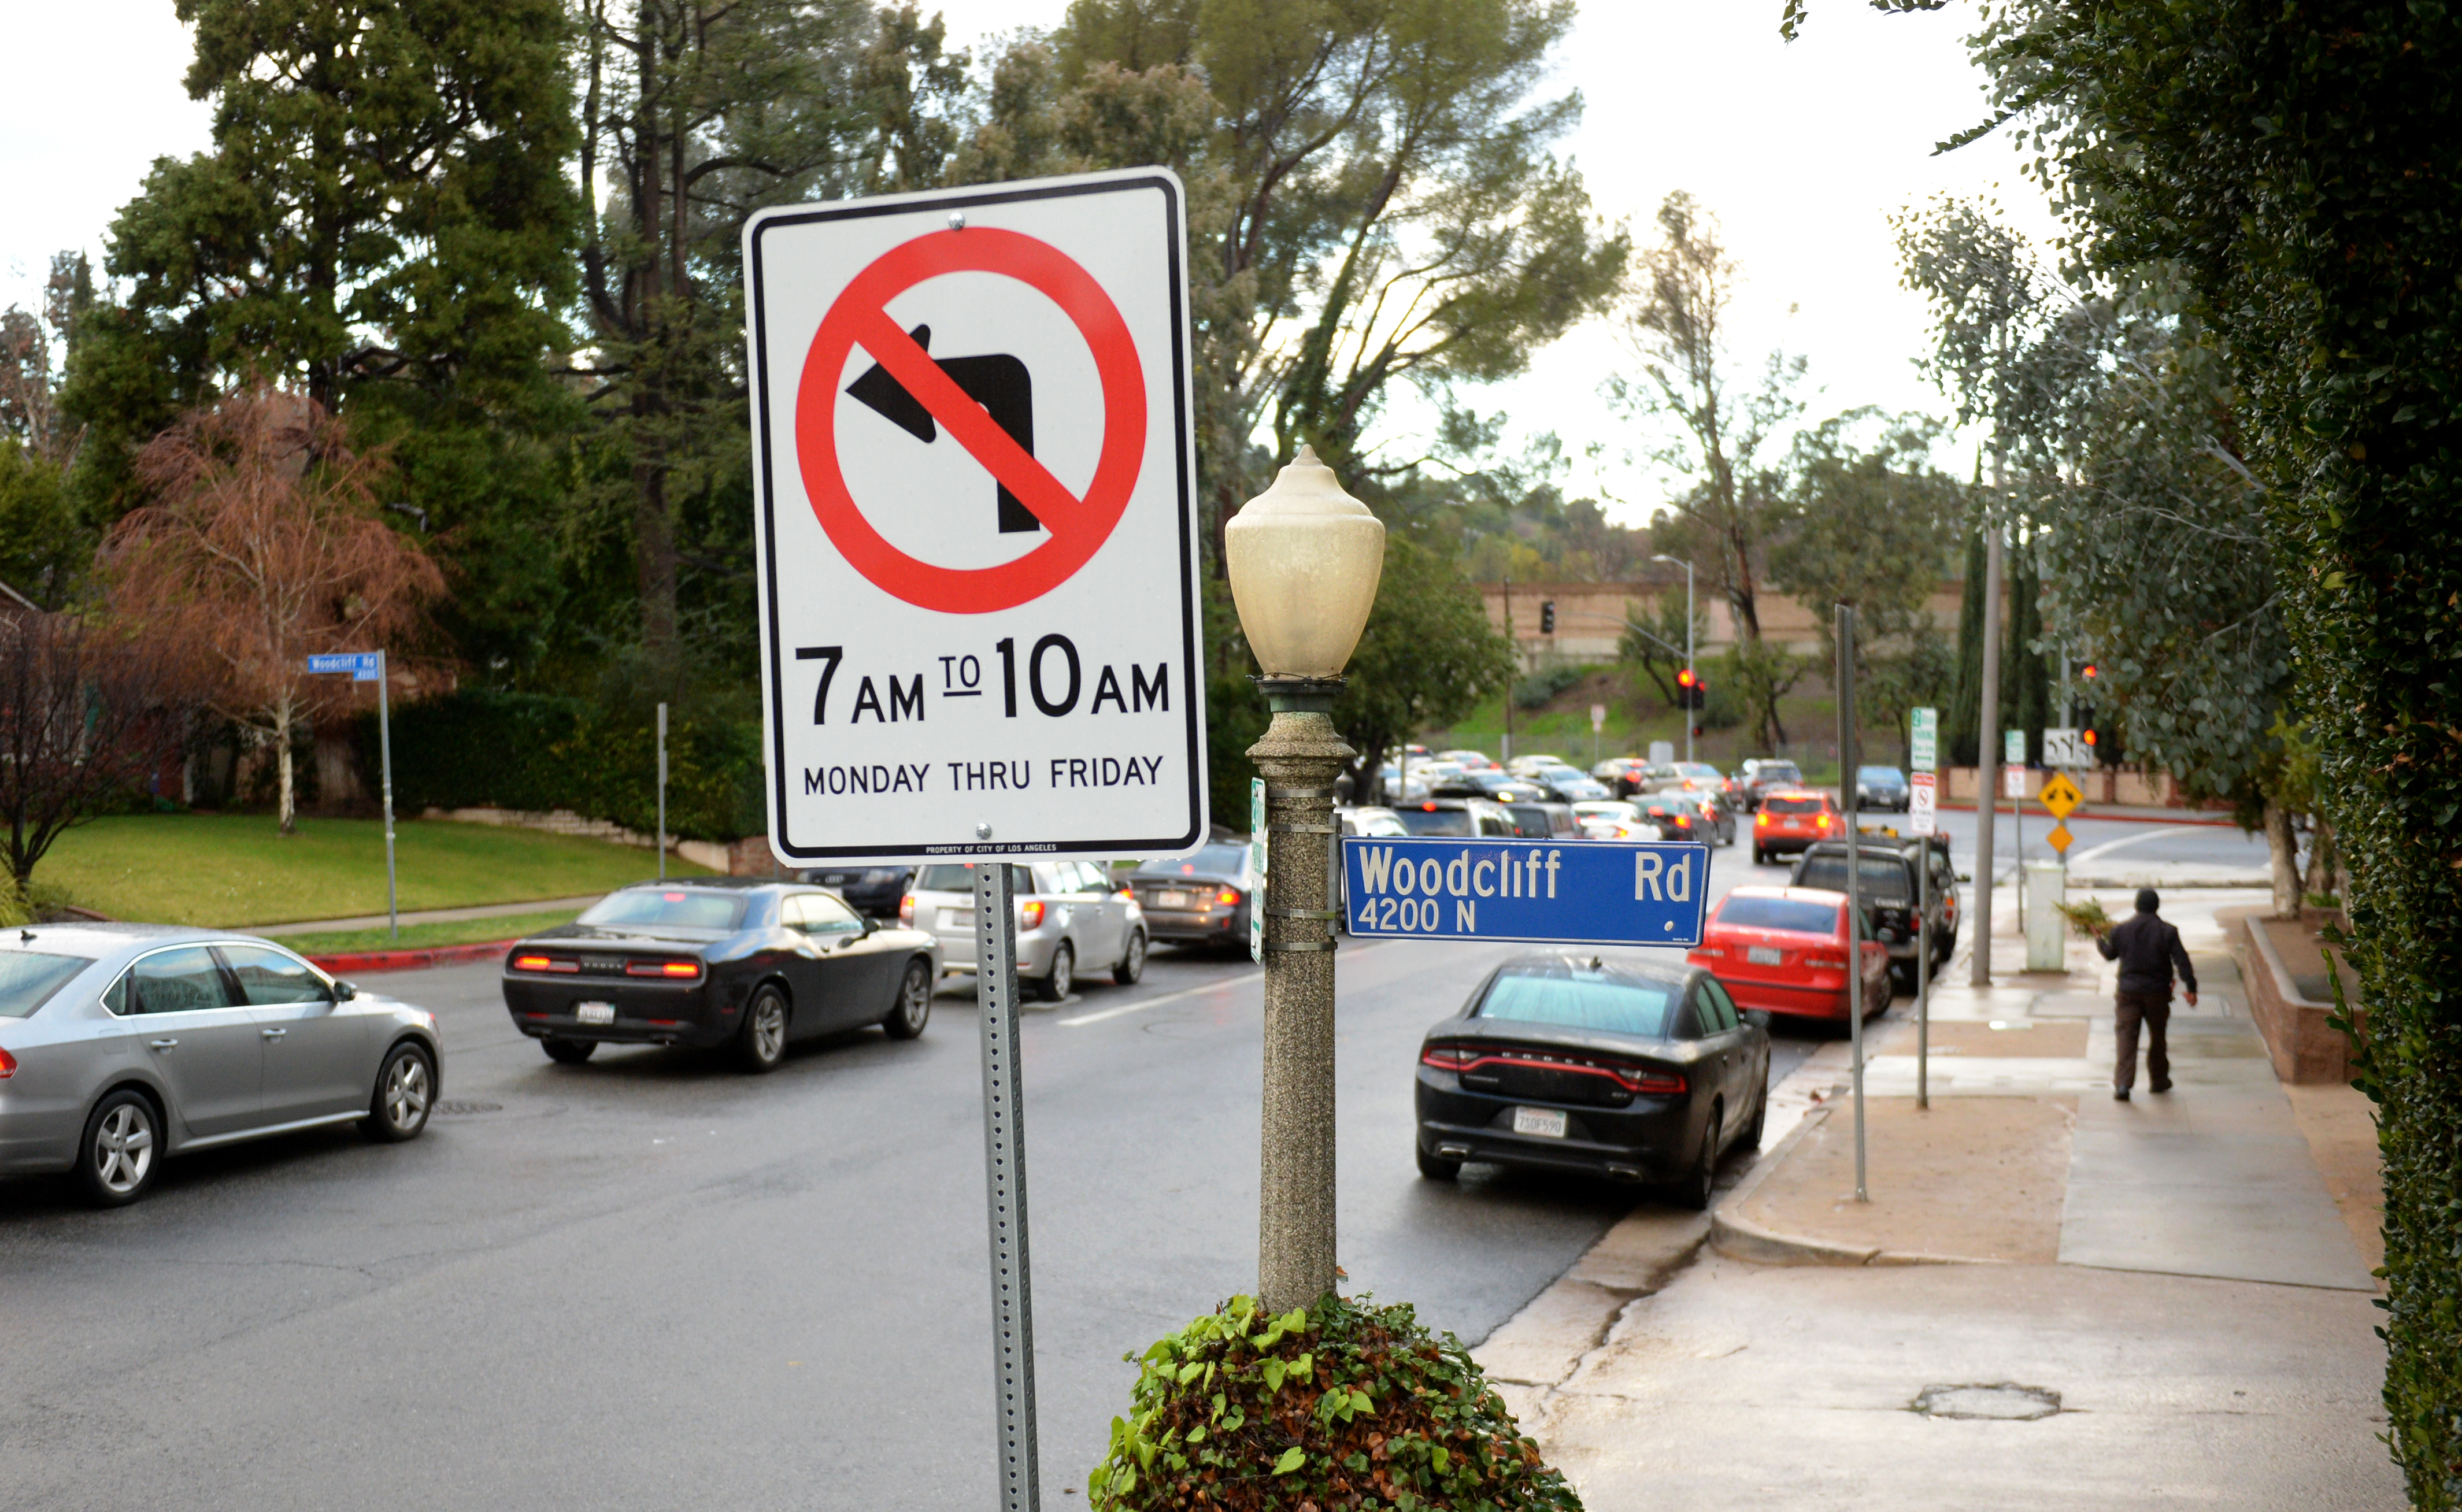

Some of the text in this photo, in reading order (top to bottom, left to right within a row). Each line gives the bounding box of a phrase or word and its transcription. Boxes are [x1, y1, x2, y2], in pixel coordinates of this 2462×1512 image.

[313, 656, 374, 669] Woodcliff Rd
[938, 654, 981, 690] TO
[804, 755, 1164, 795] MONDAY THRU FRIDAY
[1024, 844, 1057, 852] ANGELES
[1358, 846, 1690, 902] Woodcliff Rd
[1358, 898, 1475, 932] 4200 N
